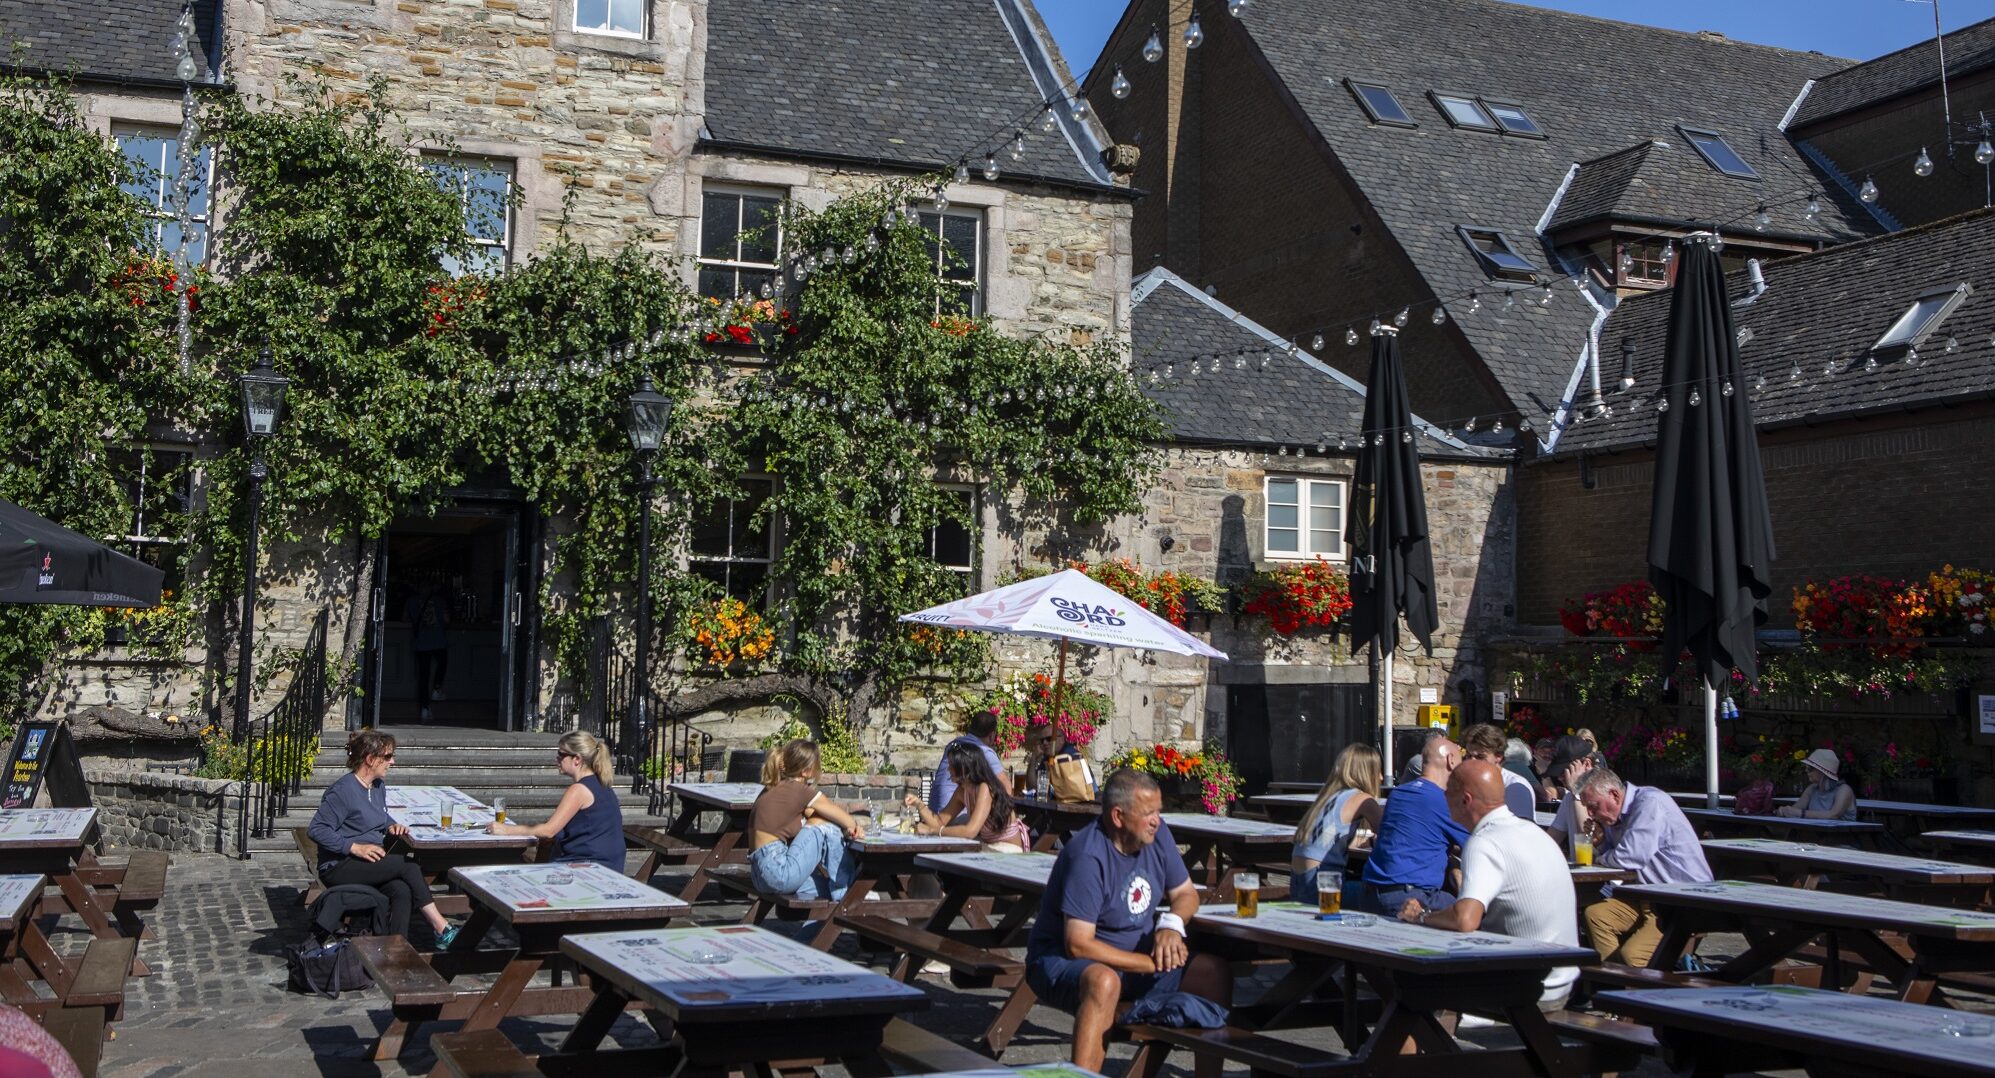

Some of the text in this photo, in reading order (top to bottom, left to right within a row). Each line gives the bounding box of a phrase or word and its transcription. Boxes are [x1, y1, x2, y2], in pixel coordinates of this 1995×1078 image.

[1032, 623, 1165, 646] Alcoholic sparkling water
